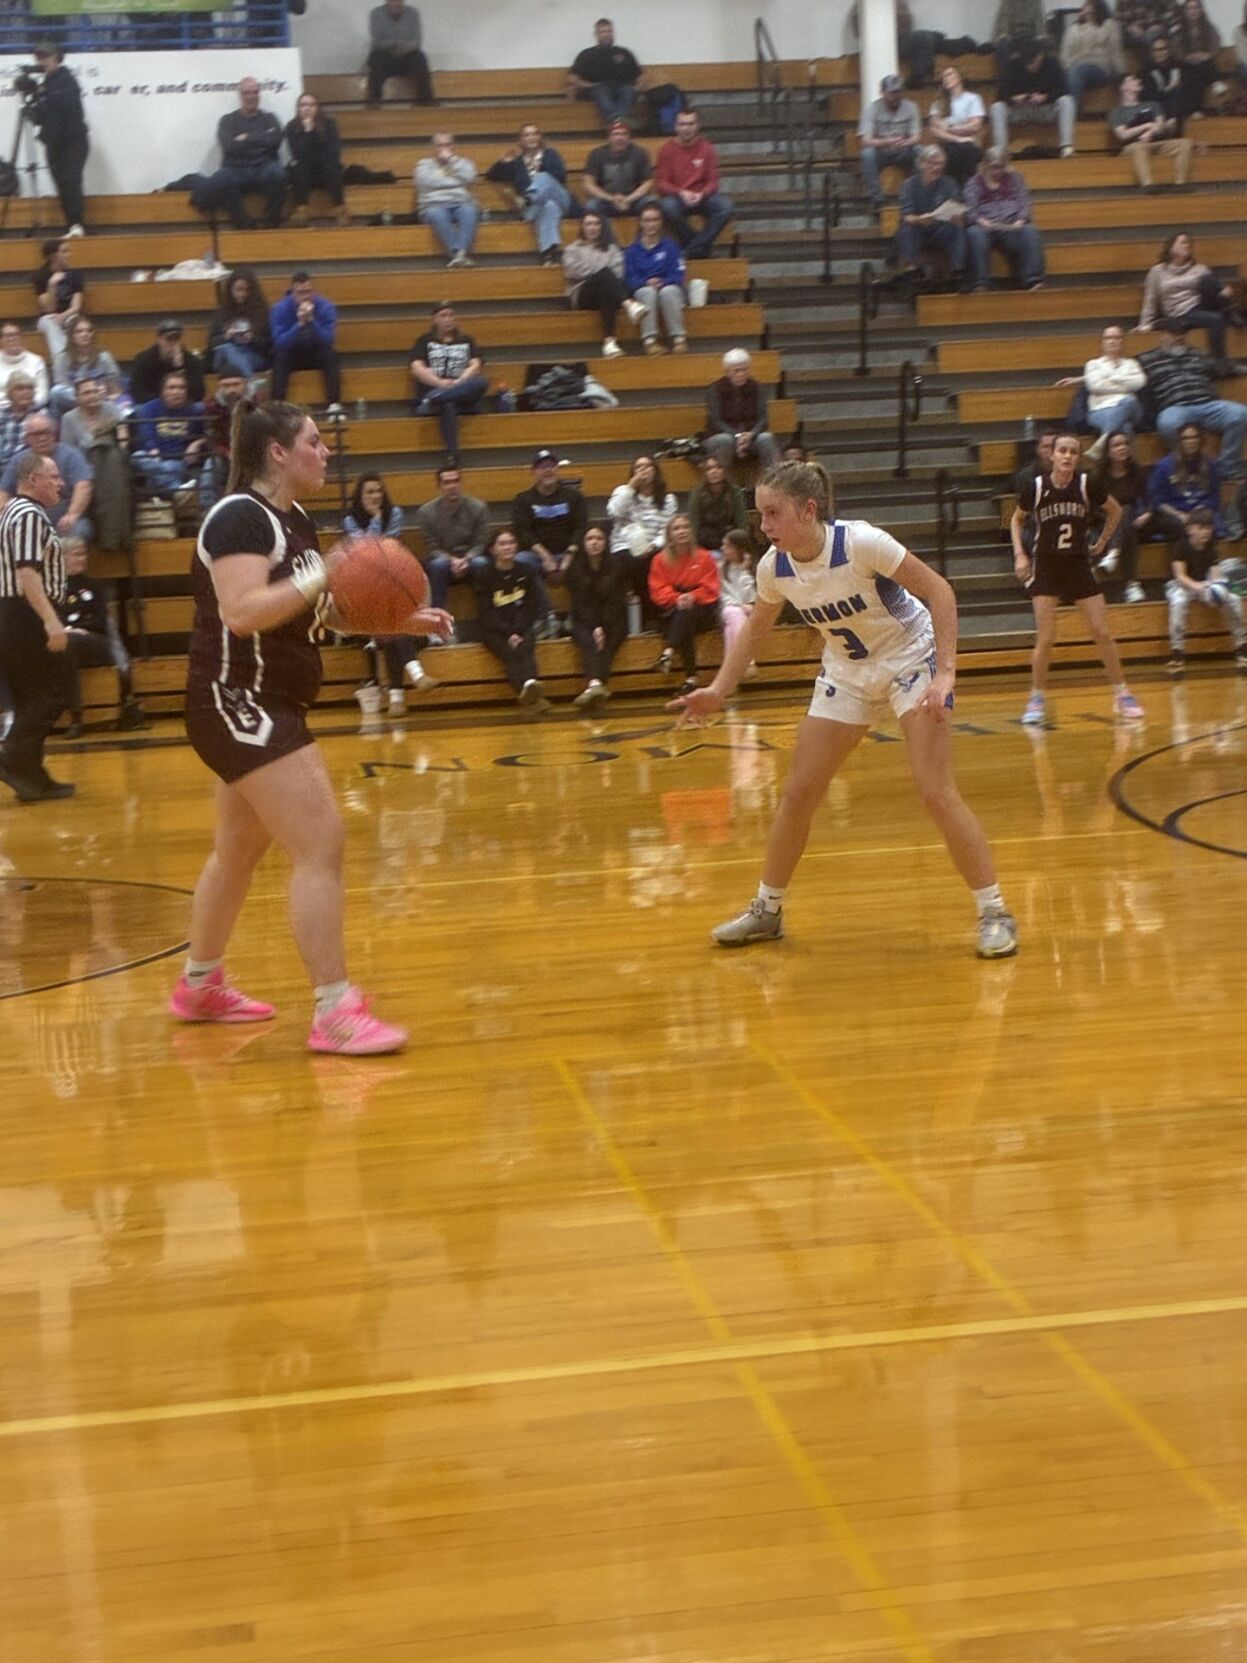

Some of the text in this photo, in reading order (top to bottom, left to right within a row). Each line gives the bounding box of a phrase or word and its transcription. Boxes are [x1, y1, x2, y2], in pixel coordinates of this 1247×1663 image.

[157, 80, 188, 94] and
[191, 77, 289, 93] commity.
[1057, 523, 1073, 550] 2
[800, 593, 868, 624] ERMON
[828, 627, 869, 661] 3
